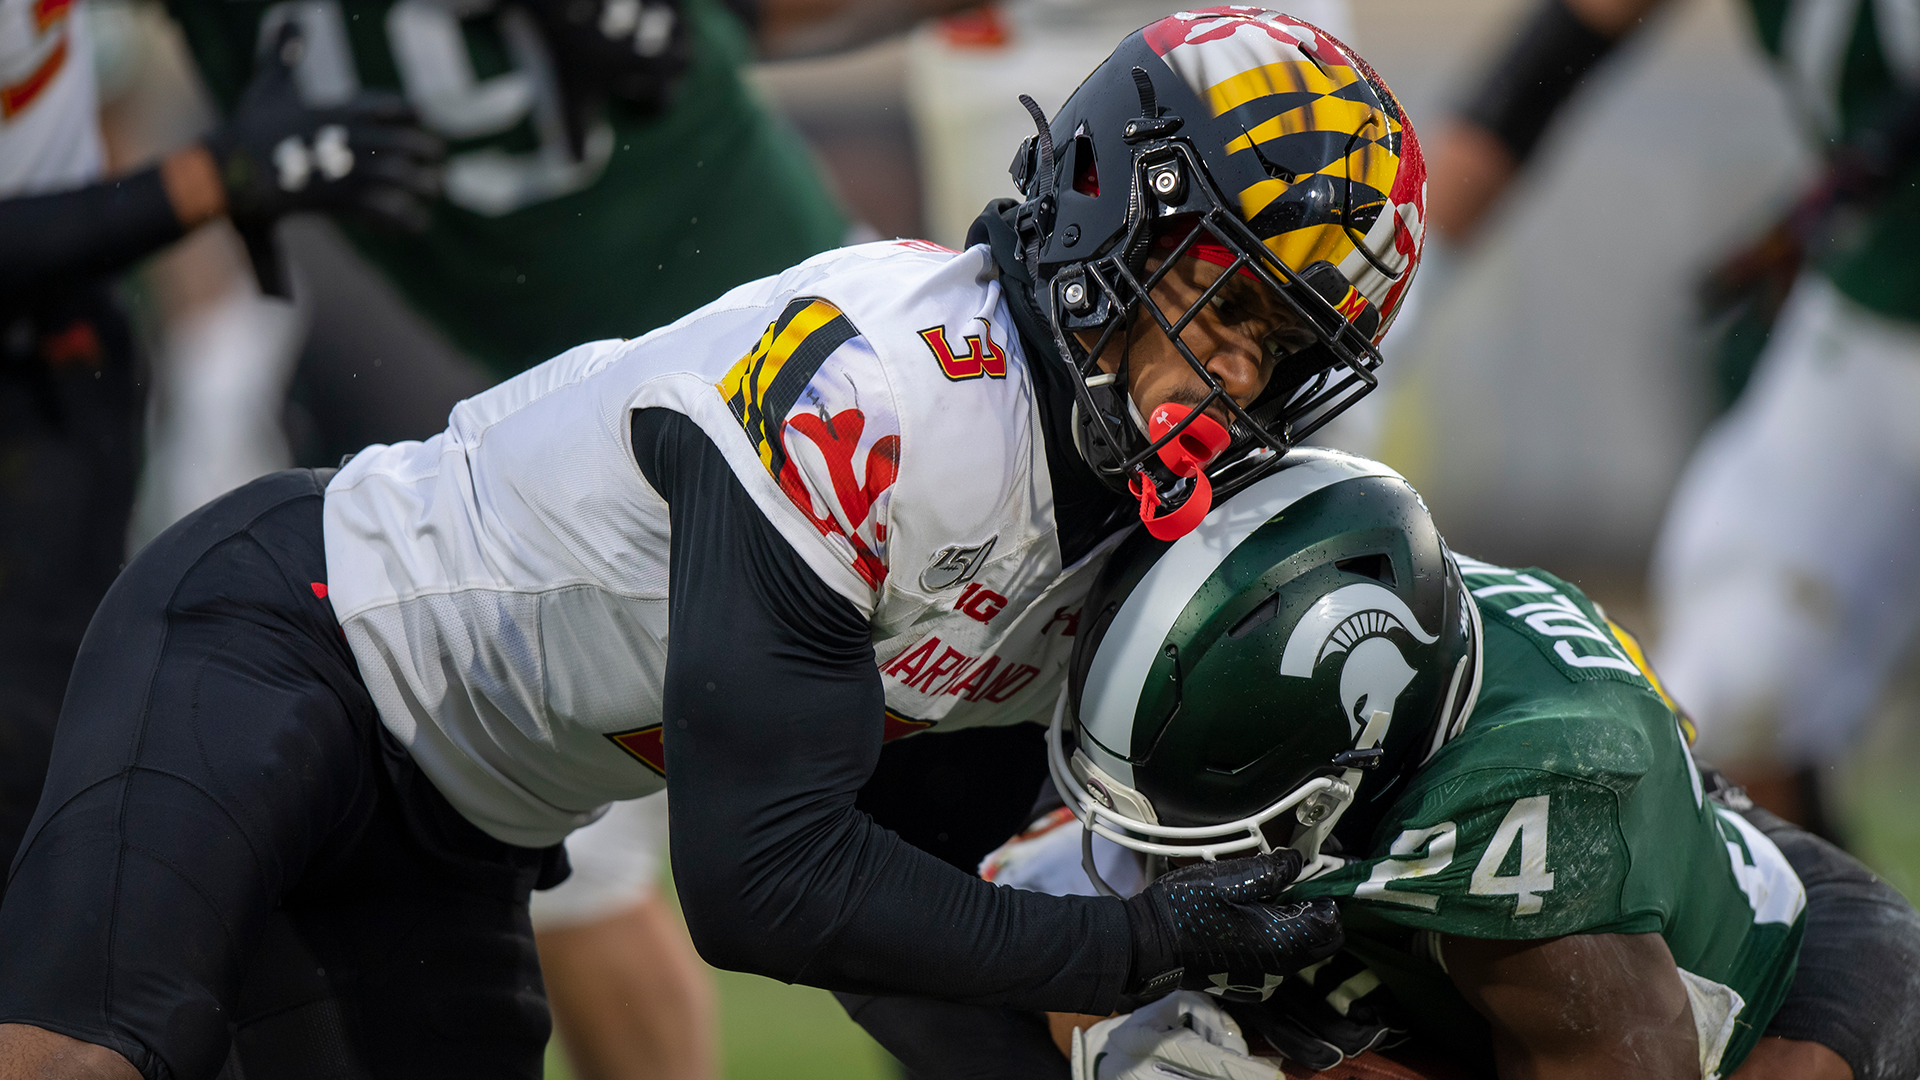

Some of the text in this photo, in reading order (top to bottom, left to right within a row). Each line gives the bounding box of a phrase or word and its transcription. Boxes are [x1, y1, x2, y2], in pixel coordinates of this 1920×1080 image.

[1334, 285, 1369, 325] M
[916, 317, 1006, 382] 3
[1353, 794, 1554, 916] 24
